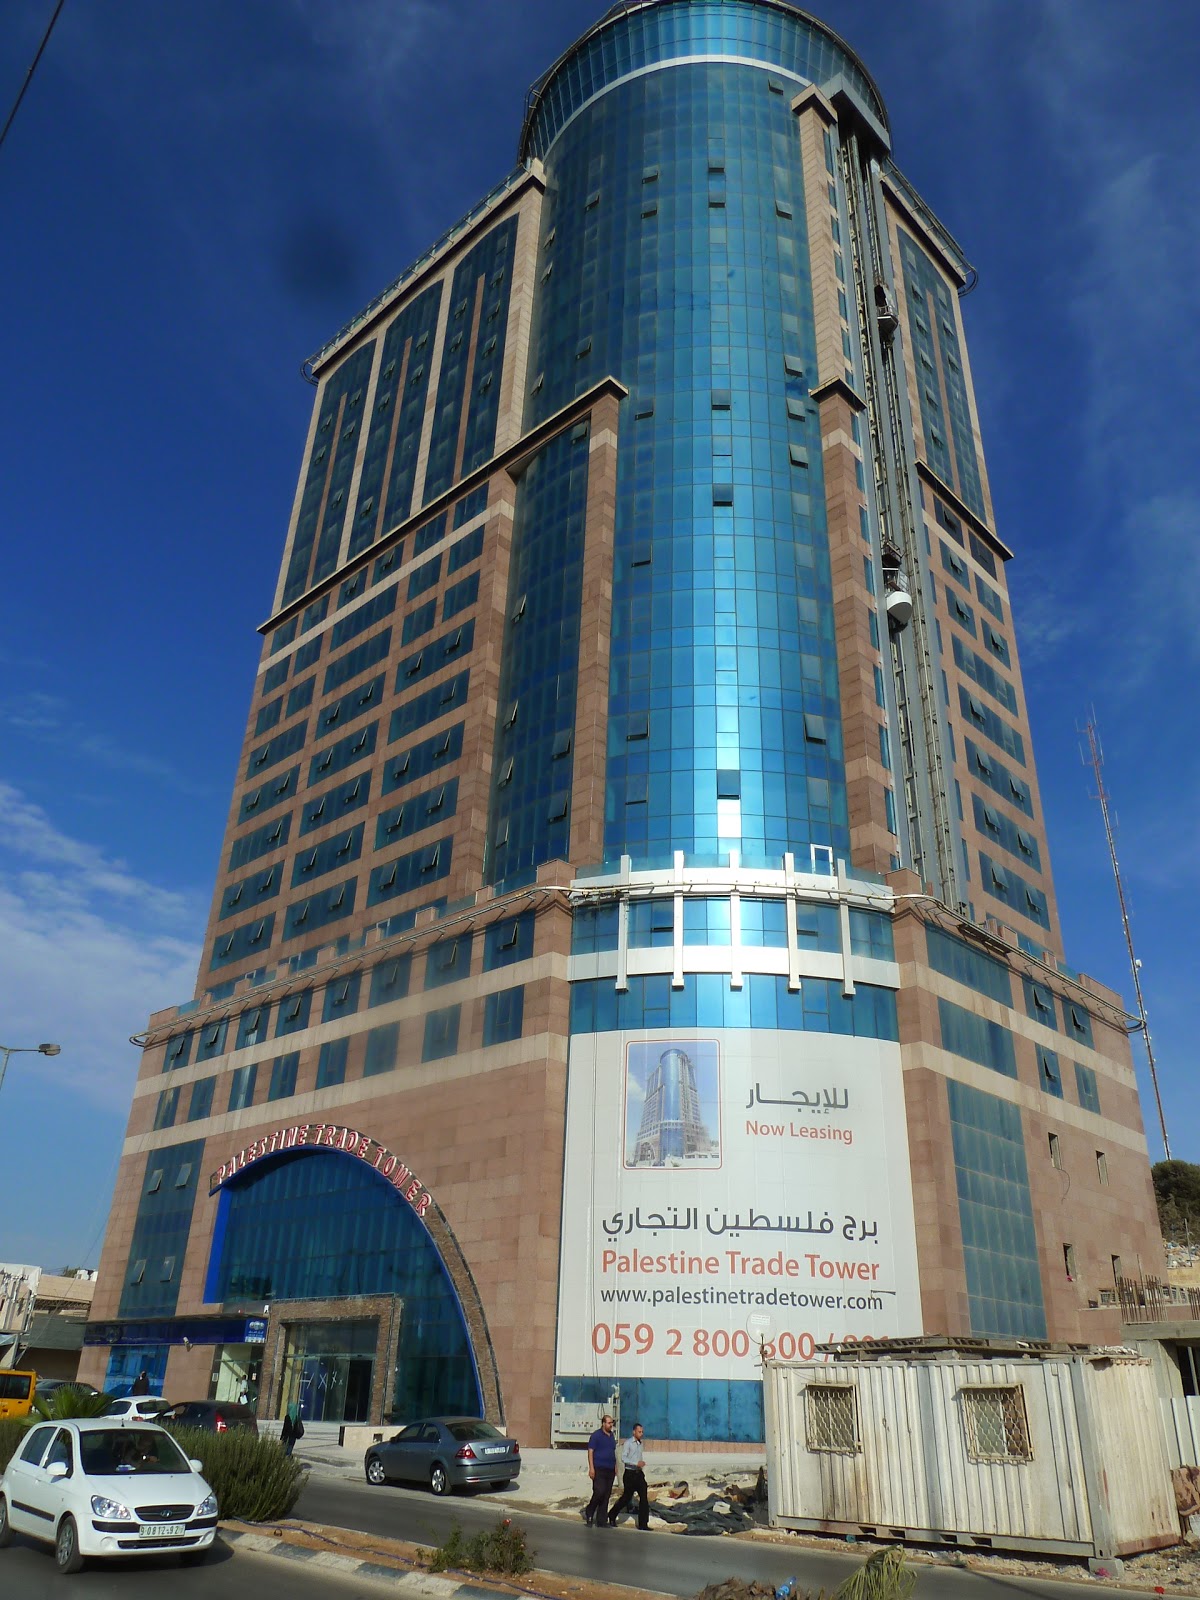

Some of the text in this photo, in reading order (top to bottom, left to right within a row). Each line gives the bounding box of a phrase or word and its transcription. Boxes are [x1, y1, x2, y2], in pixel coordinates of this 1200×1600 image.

[746, 1083, 849, 1114] للإيجار
[746, 1120, 853, 1145] Now Leasing
[216, 1124, 432, 1217] PALESTINE TRADE TOWER
[602, 1206, 879, 1244] برج فلسطين التجاري
[602, 1248, 880, 1280] Palestine Trade Tower
[601, 1286, 883, 1310] www.palestinetradetower.com
[591, 1322, 655, 1355] 059
[665, 1328, 683, 1356] 2
[692, 1329, 750, 1358] 800
